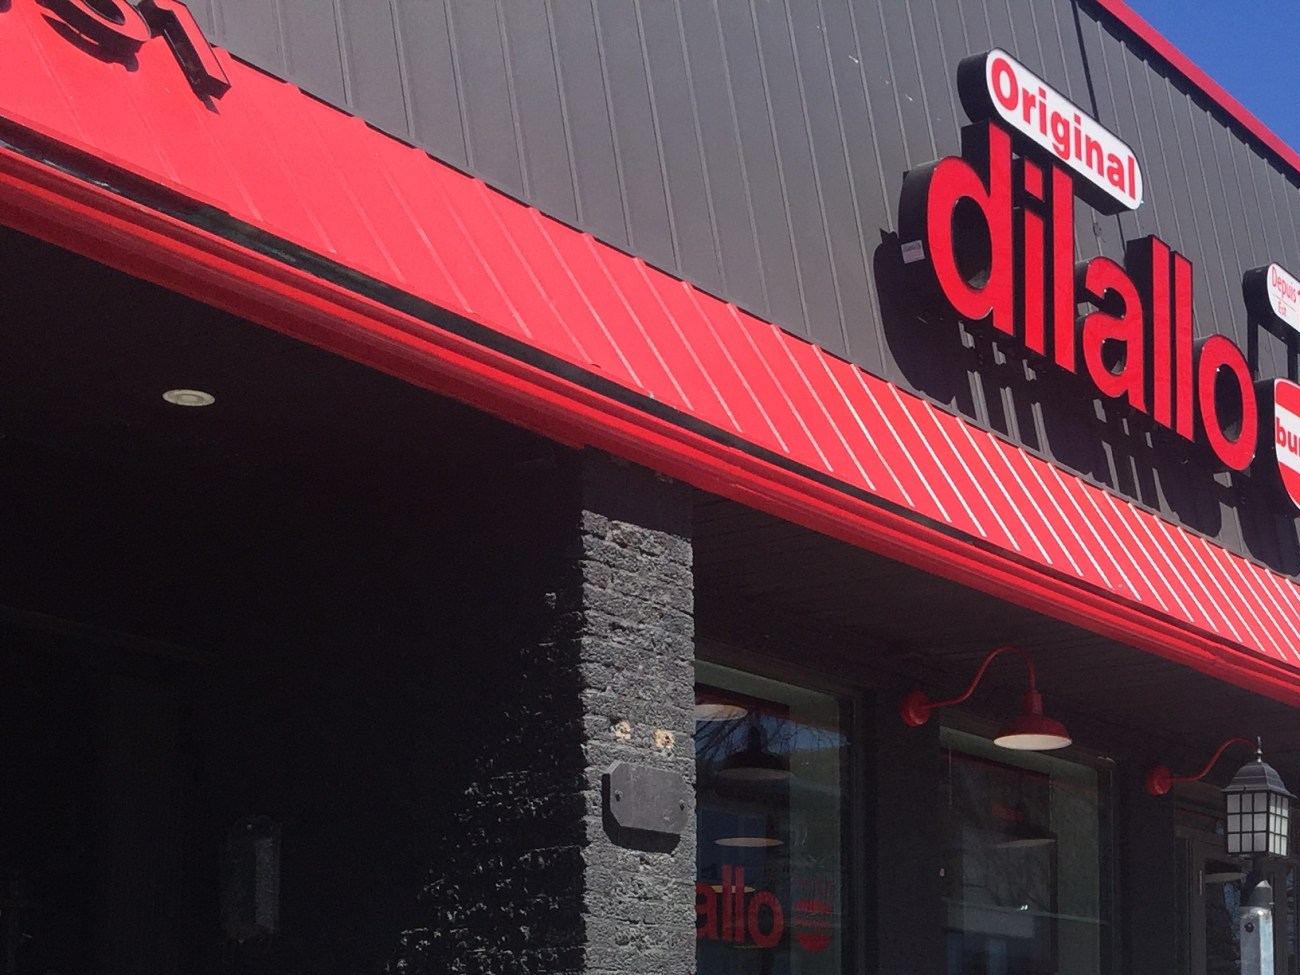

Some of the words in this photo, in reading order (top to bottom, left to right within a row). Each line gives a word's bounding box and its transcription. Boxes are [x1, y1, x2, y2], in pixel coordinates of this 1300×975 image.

[991, 57, 1136, 201] Original
[926, 120, 1259, 472] dilallo
[1271, 265, 1298, 303] Depuis
